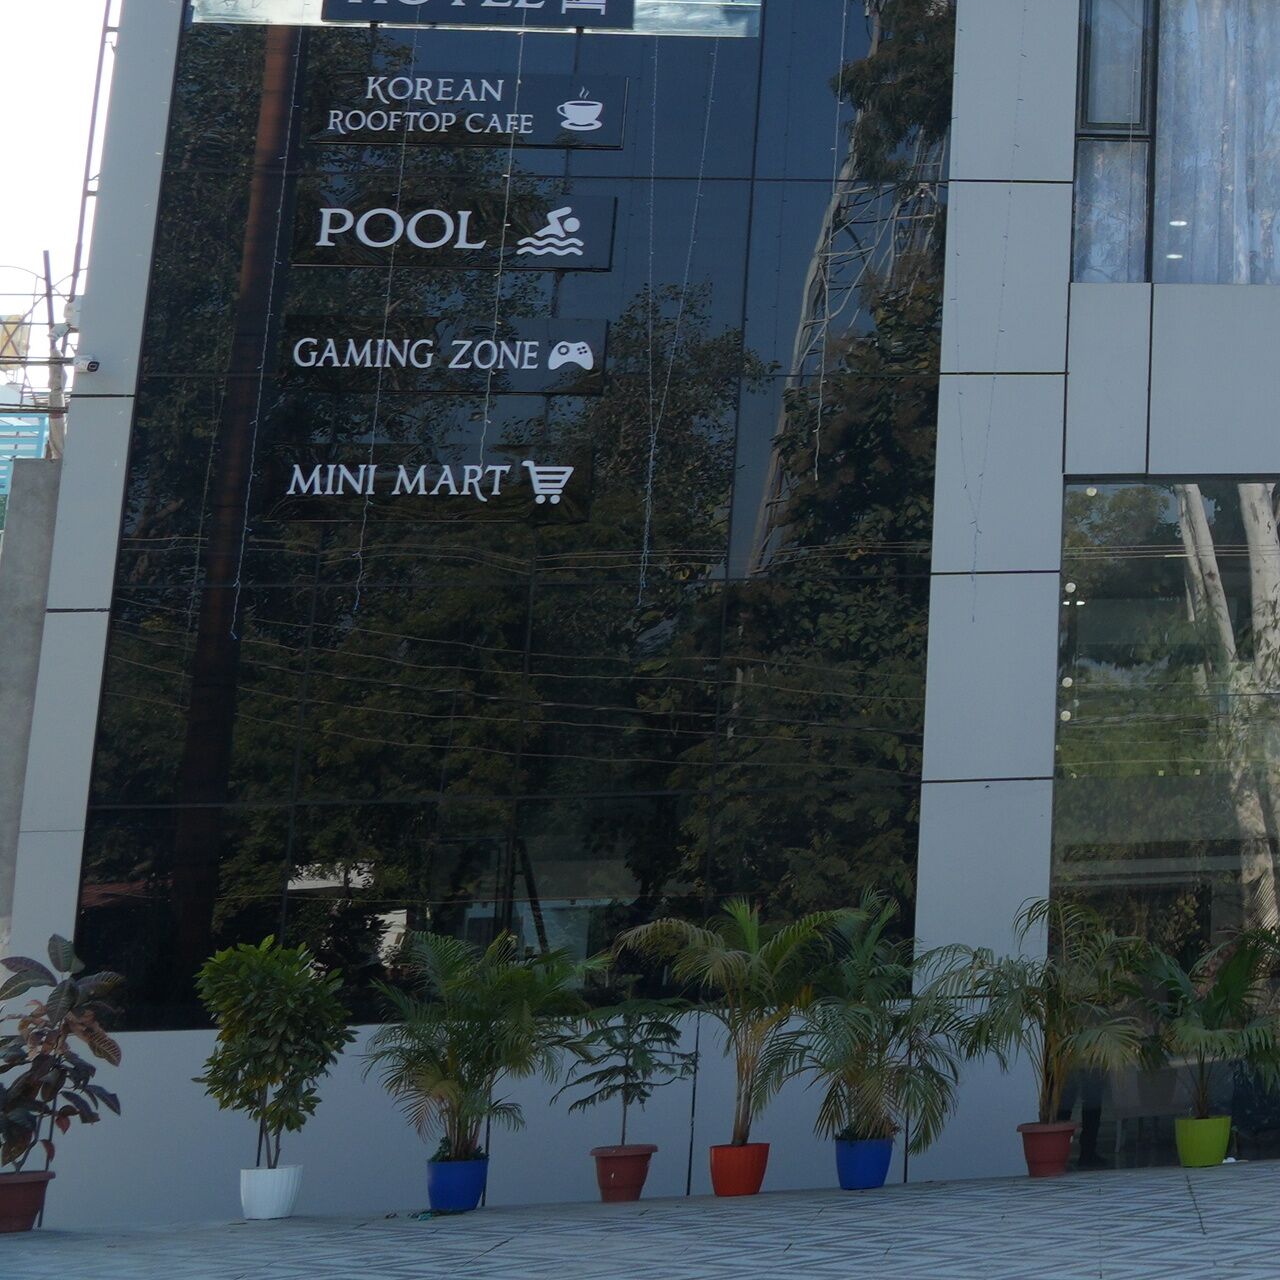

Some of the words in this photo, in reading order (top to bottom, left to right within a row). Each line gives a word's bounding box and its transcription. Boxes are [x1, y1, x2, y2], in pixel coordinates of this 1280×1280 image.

[365, 75, 505, 104] KOREAN
[327, 109, 458, 135] ROOFTOP
[464, 112, 534, 135] CAFE
[315, 207, 487, 250] POOL
[293, 336, 435, 369] GAMING
[449, 339, 539, 370] ZONE
[286, 463, 377, 496] MINI
[391, 464, 512, 502] MART
